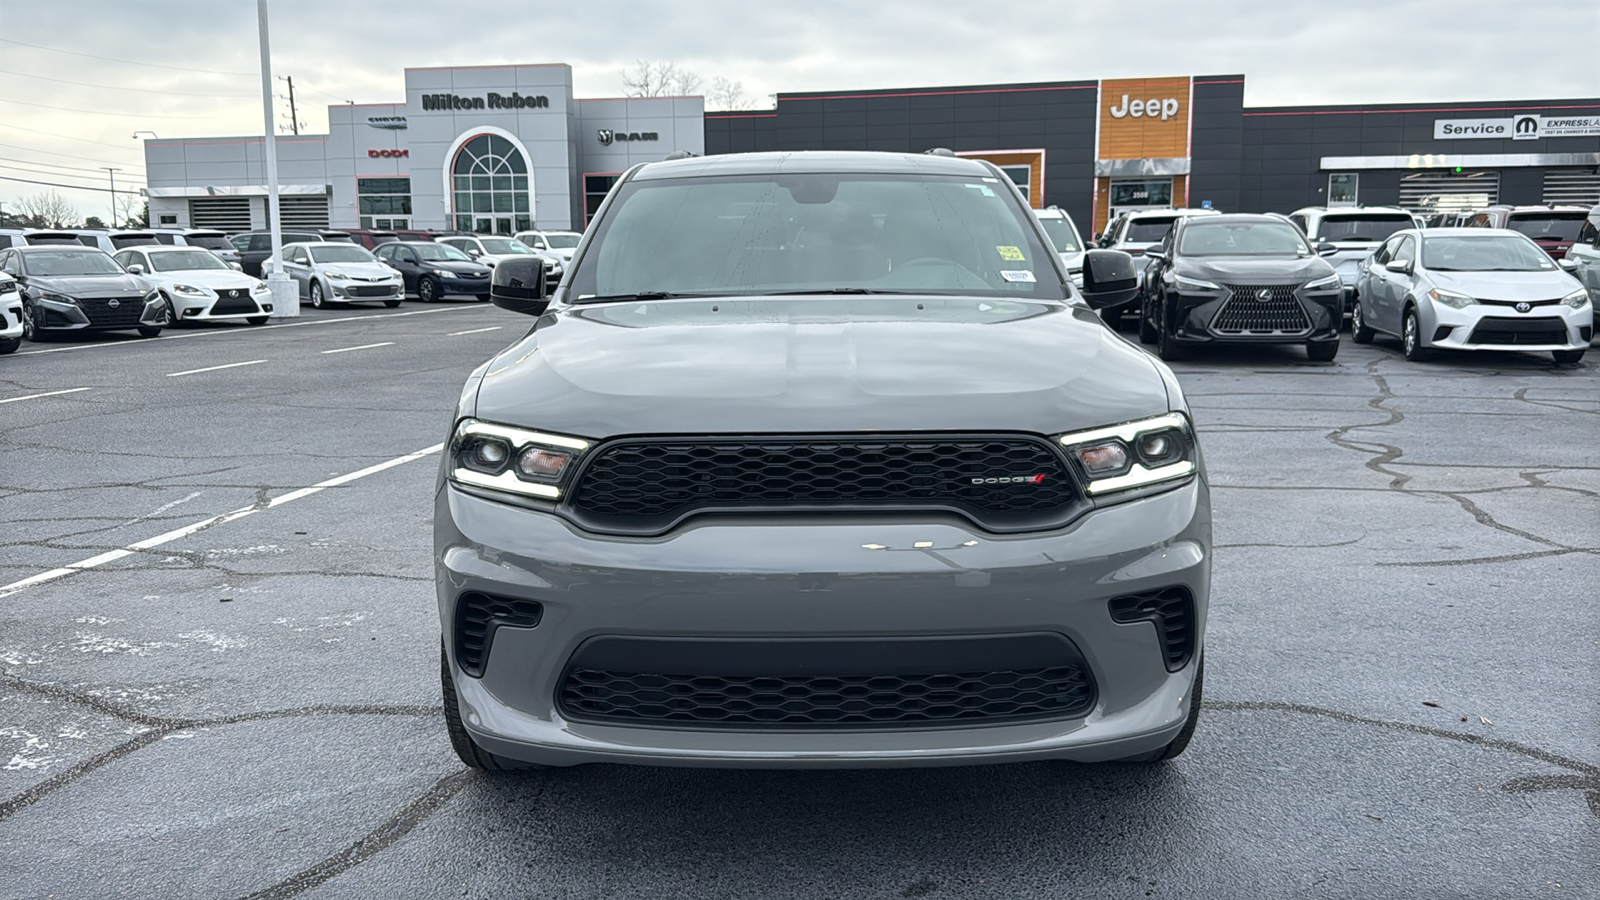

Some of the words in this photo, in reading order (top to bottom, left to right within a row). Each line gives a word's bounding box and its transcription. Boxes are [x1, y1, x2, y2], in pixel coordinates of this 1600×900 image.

[422, 93, 485, 111] Milton
[487, 92, 549, 109] Ruben
[1110, 94, 1179, 121] Jeep
[1443, 123, 1505, 135] Service
[615, 132, 659, 142] RAM
[972, 476, 1036, 485] DODGE
